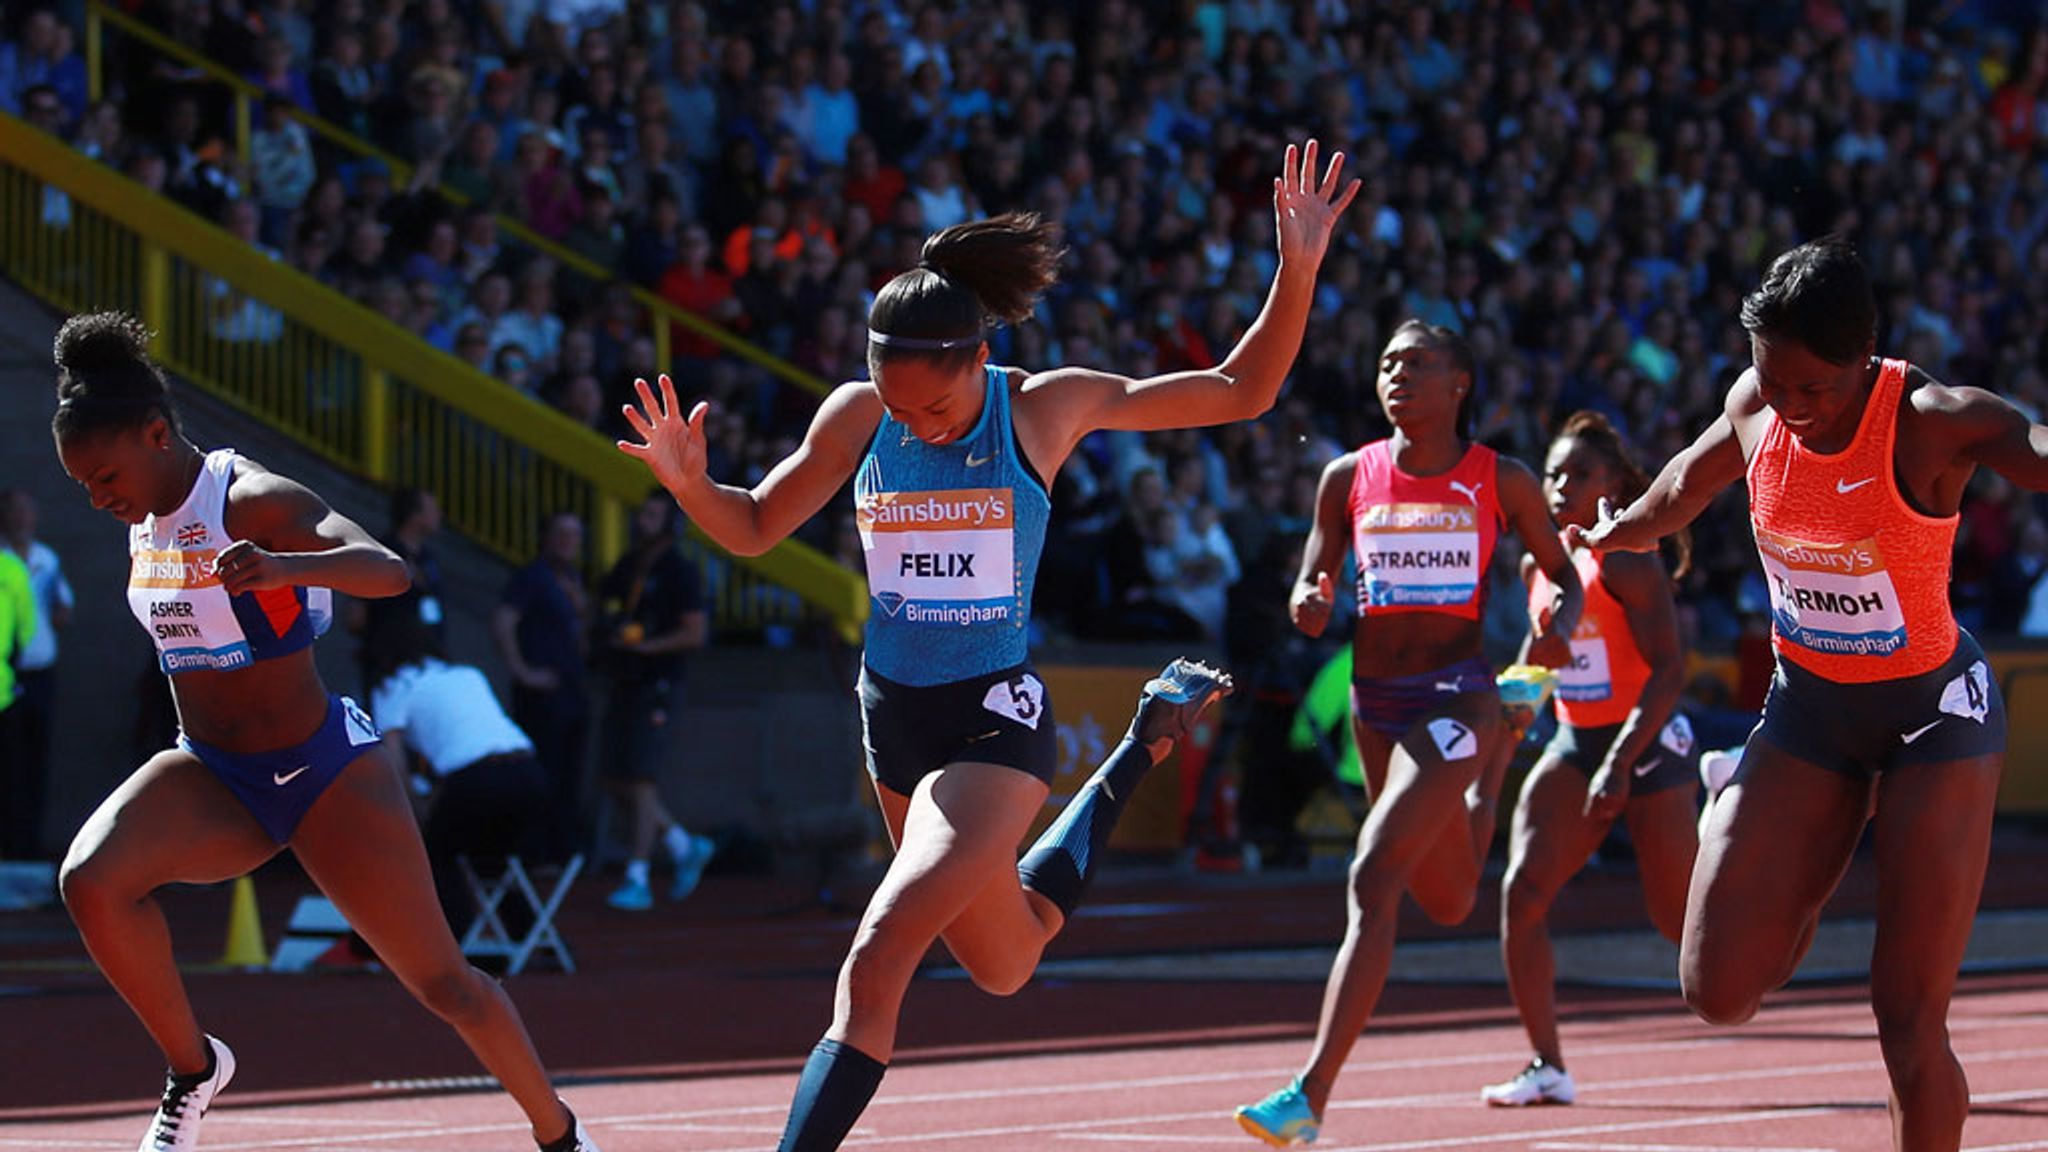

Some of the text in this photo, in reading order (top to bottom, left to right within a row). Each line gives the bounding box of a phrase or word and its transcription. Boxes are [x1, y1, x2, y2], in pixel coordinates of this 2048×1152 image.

[864, 495, 1006, 525] Sainsbury's
[1364, 507, 1472, 530] ainsbury's
[899, 553, 975, 577] FELIX
[1368, 550, 1471, 569] STRACHAN
[150, 602, 194, 617] ASHER
[905, 603, 1008, 626] Birmingham
[156, 624, 201, 639] SMITH
[1801, 630, 1901, 655] Birmingham
[1008, 677, 1035, 719] 5
[1964, 671, 1986, 711] 4
[1445, 723, 1467, 751] 7
